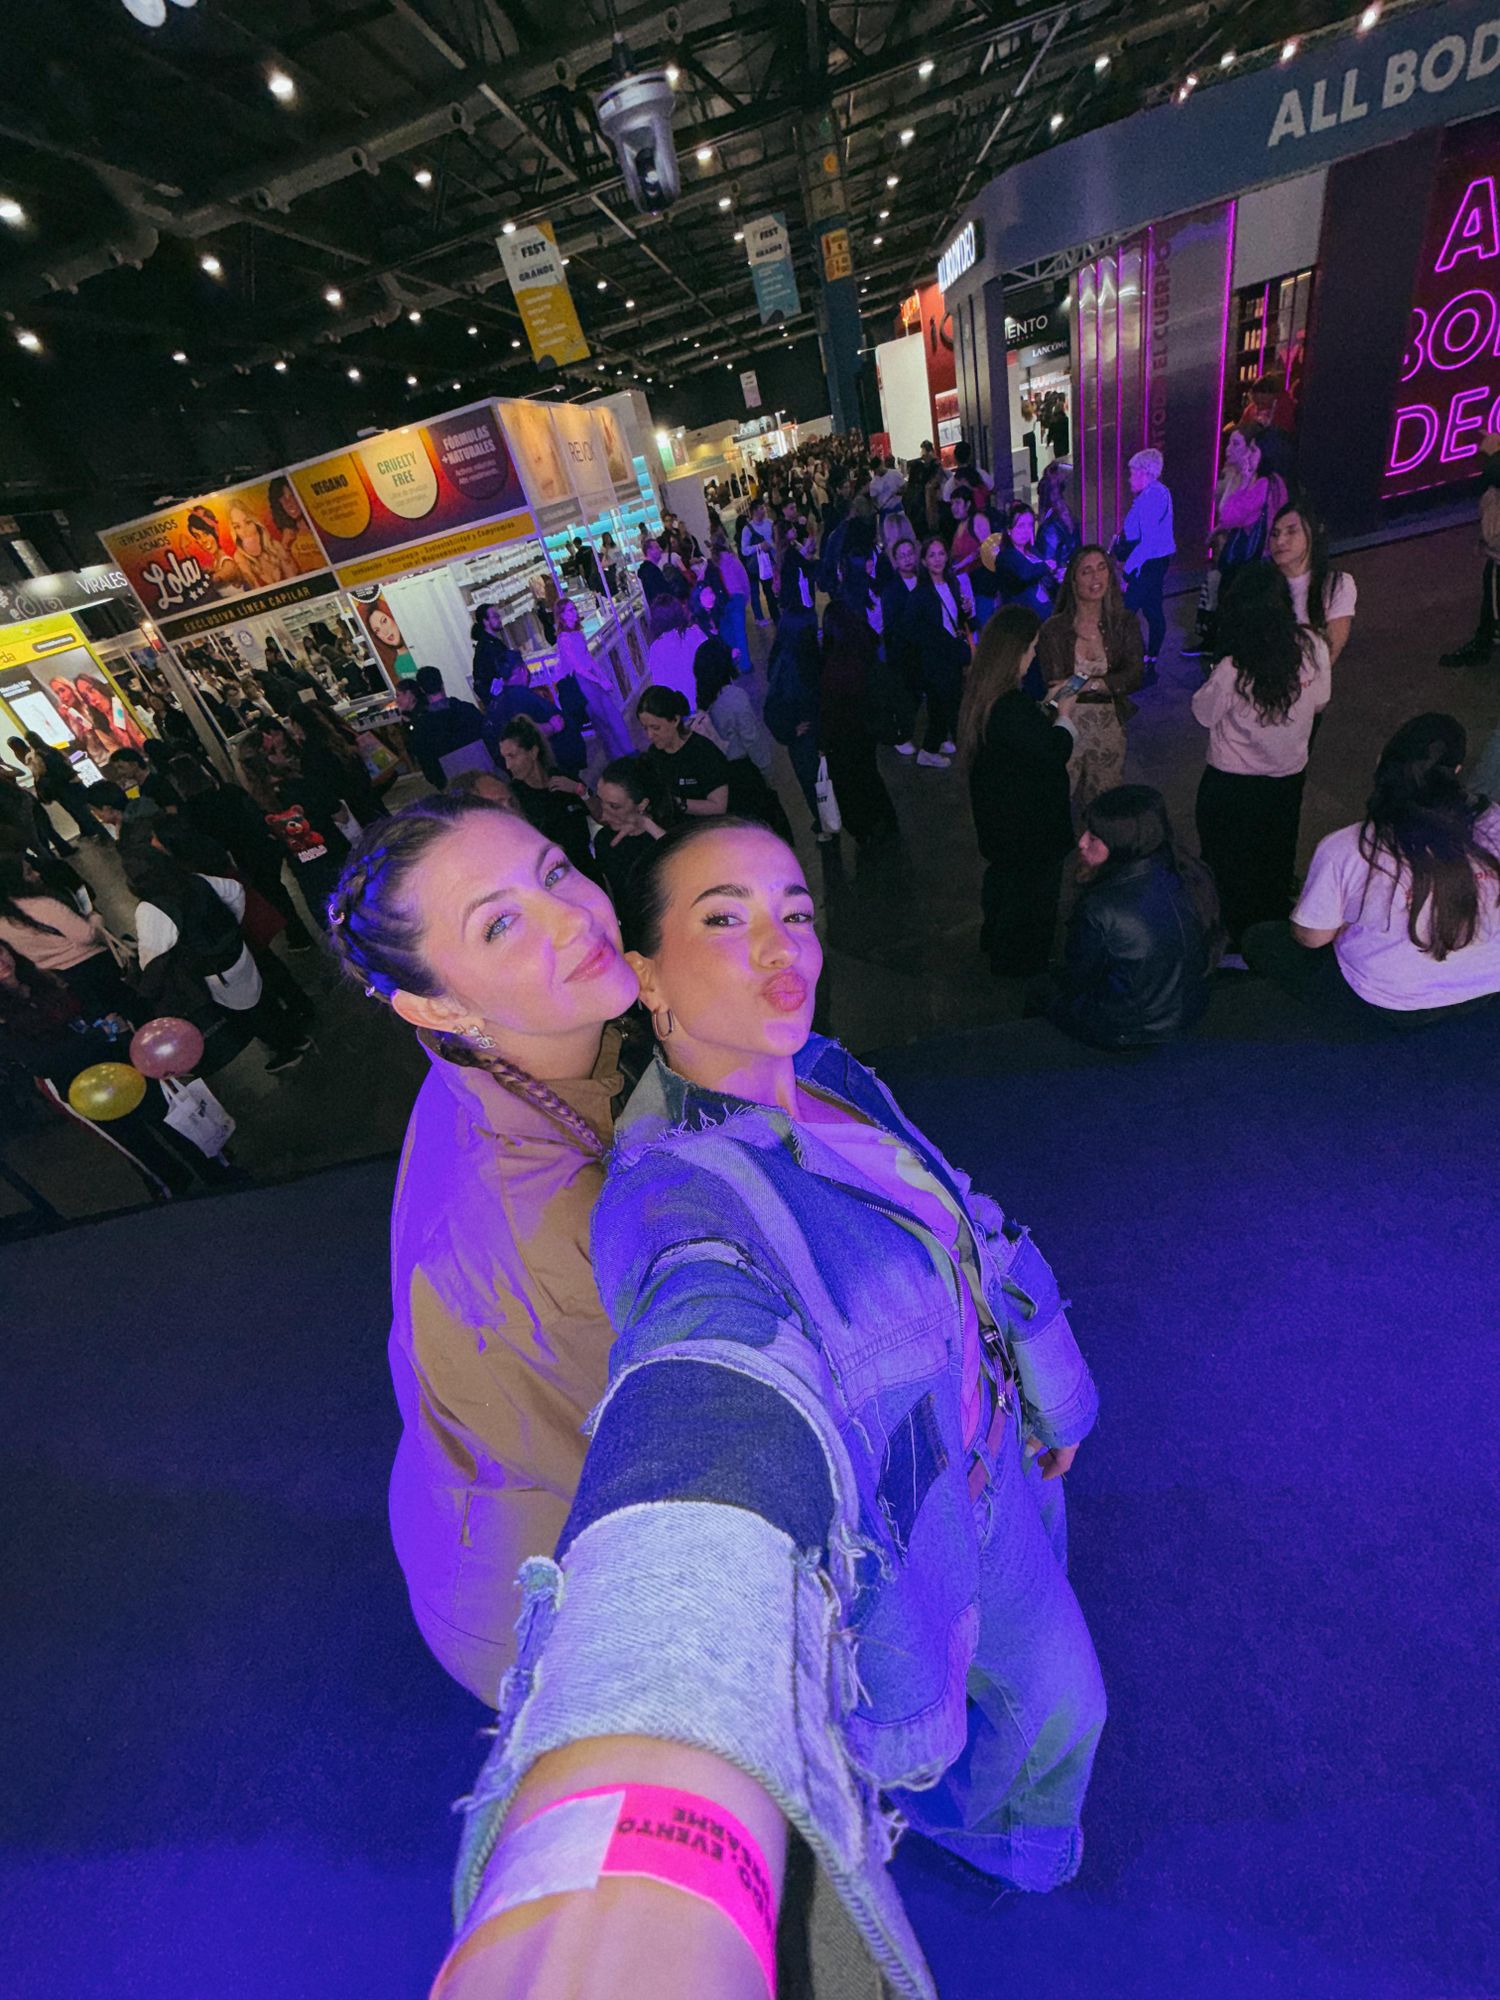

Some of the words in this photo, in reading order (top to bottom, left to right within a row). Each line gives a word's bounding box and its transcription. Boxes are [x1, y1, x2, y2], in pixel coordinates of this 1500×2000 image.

[1267, 68, 1369, 148] ALL
[1381, 18, 1500, 110] BOD
[759, 226, 779, 241] FEST
[520, 240, 547, 259] FEST
[518, 263, 555, 283] GRANDE
[1152, 240, 1172, 339] CUERPO
[1004, 314, 1049, 340] ENTO
[1399, 287, 1500, 382] BO
[1152, 343, 1169, 370] EL
[442, 424, 491, 451] FÓRMULAS
[376, 450, 418, 476] CRUELTY
[310, 473, 349, 497] VEGANO
[391, 470, 416, 488] FREE
[76, 571, 129, 595] VIRALES
[142, 551, 202, 611] Lola
[183, 610, 236, 633] EXCLUSIVA
[237, 601, 268, 617] LÍNEA
[268, 585, 312, 608] CAPILAR
[617, 1818, 724, 1861] EVENTO
